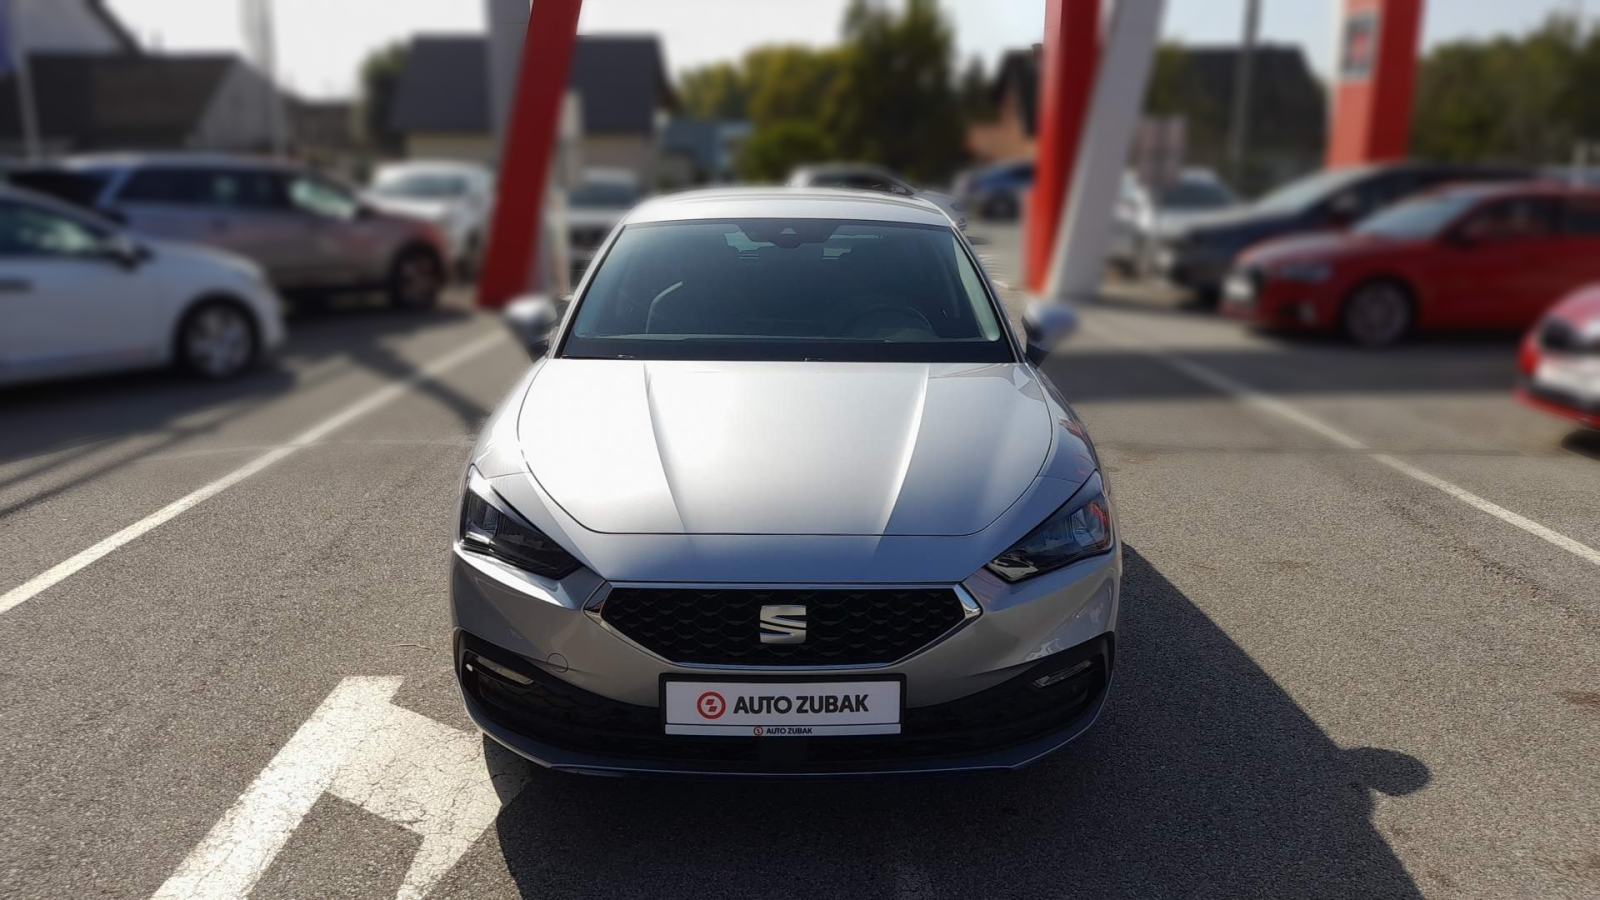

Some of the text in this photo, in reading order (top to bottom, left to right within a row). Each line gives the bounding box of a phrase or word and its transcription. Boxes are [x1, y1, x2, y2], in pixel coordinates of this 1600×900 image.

[733, 694, 869, 714] AUTO ZUBAK
[766, 727, 813, 735] AUTO ZUBAK
